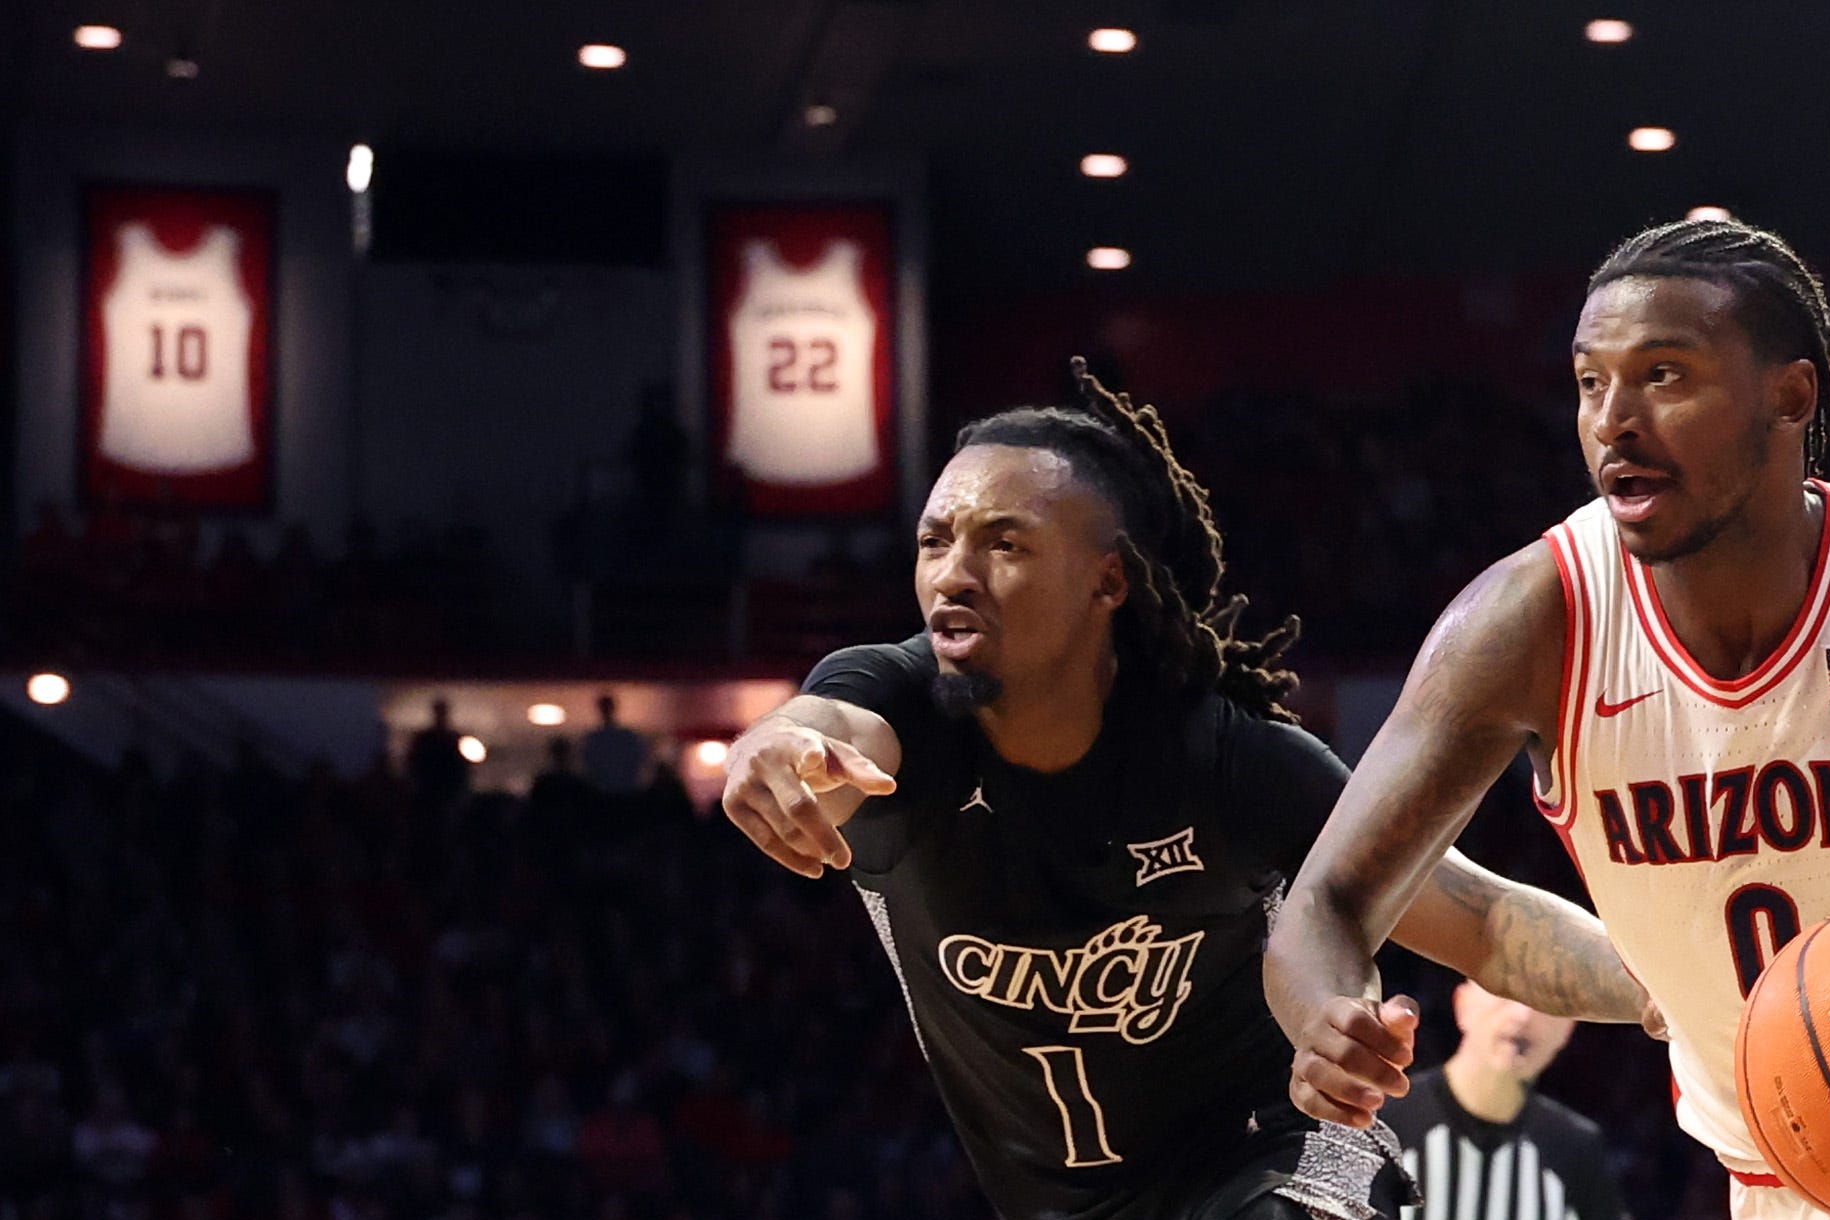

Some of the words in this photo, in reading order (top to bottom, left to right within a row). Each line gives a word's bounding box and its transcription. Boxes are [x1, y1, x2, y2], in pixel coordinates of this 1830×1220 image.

[149, 322, 208, 382] 10
[767, 337, 839, 392] 22
[1724, 882, 1802, 1002] 0
[1021, 1046, 1123, 1168] 1
